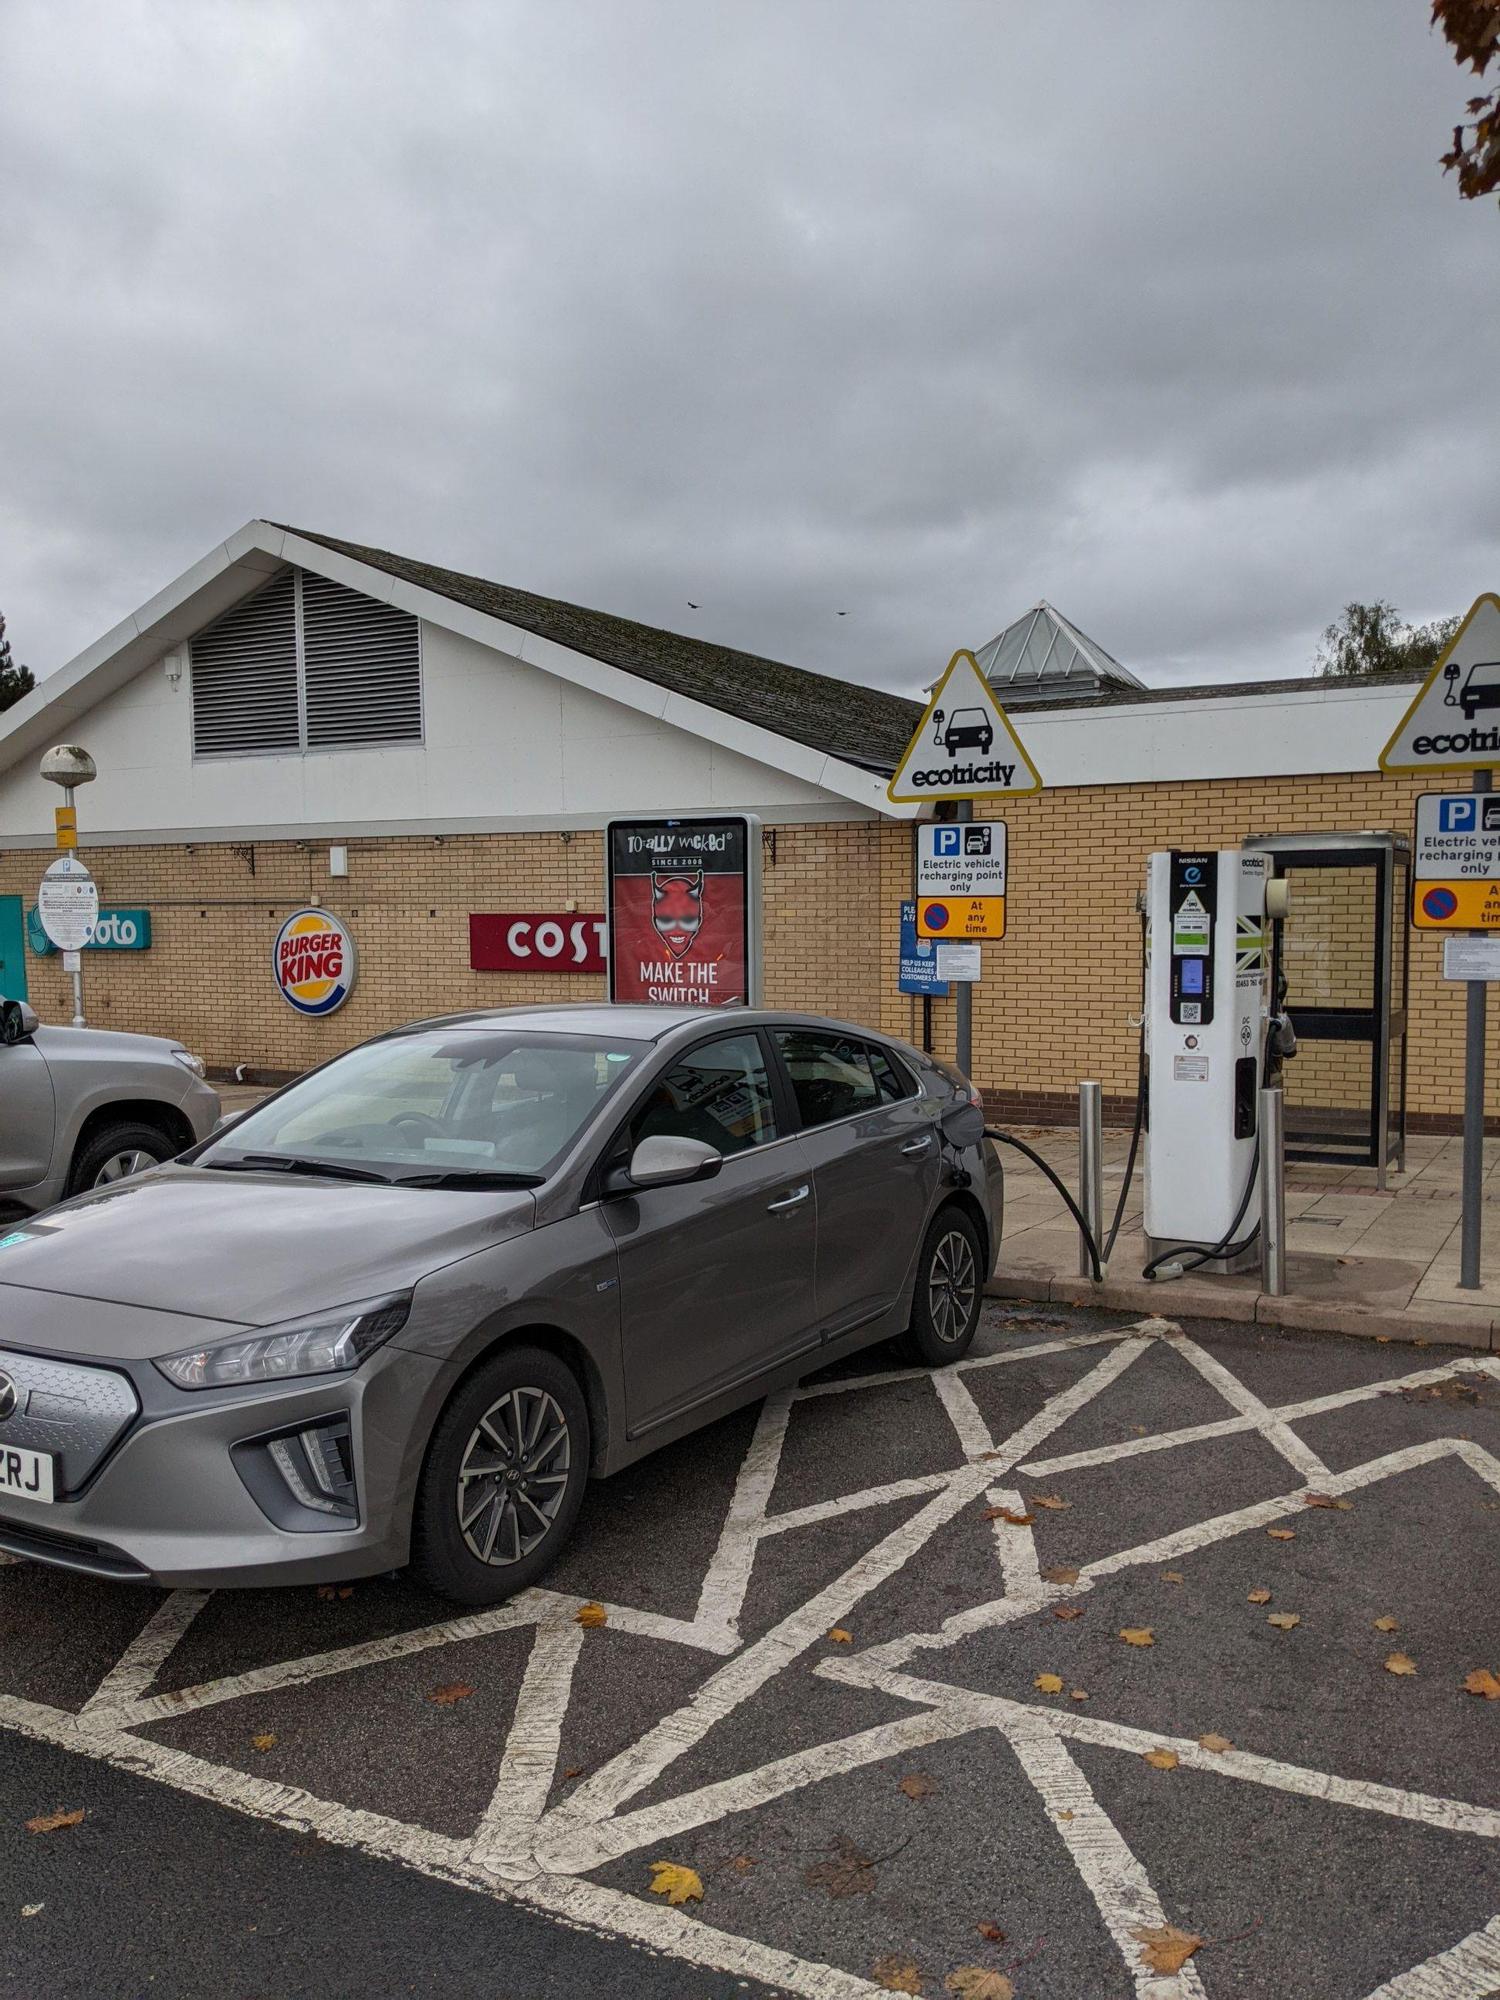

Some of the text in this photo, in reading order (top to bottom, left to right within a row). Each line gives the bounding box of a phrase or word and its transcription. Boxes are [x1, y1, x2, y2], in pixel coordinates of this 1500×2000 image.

[1412, 726, 1500, 755] ecotri
[911, 761, 1016, 787] ecotricity
[1448, 801, 1471, 830] P
[940, 830, 957, 854] P
[1424, 836, 1477, 847] Electric
[1419, 850, 1493, 862] recharging
[923, 859, 1000, 869] Electric vehicle
[1460, 863, 1490, 875] only
[920, 871, 1003, 881] recharging point
[950, 882, 971, 892] only
[1489, 885, 1500, 896] A
[903, 906, 916, 914] PLE
[970, 902, 983, 911] At
[1484, 901, 1500, 909] an
[967, 914, 985, 922] any
[1480, 912, 1500, 922] tim
[90, 914, 137, 945] oto
[965, 924, 987, 933] time
[280, 933, 343, 960] BURGER
[507, 921, 608, 964] COST
[922, 960, 935, 968] KEEP
[281, 952, 343, 988] KING
[640, 961, 718, 984] MAKE THE
[900, 973, 931, 981] CUSTOMERS
[648, 986, 709, 1003] SWITCH
